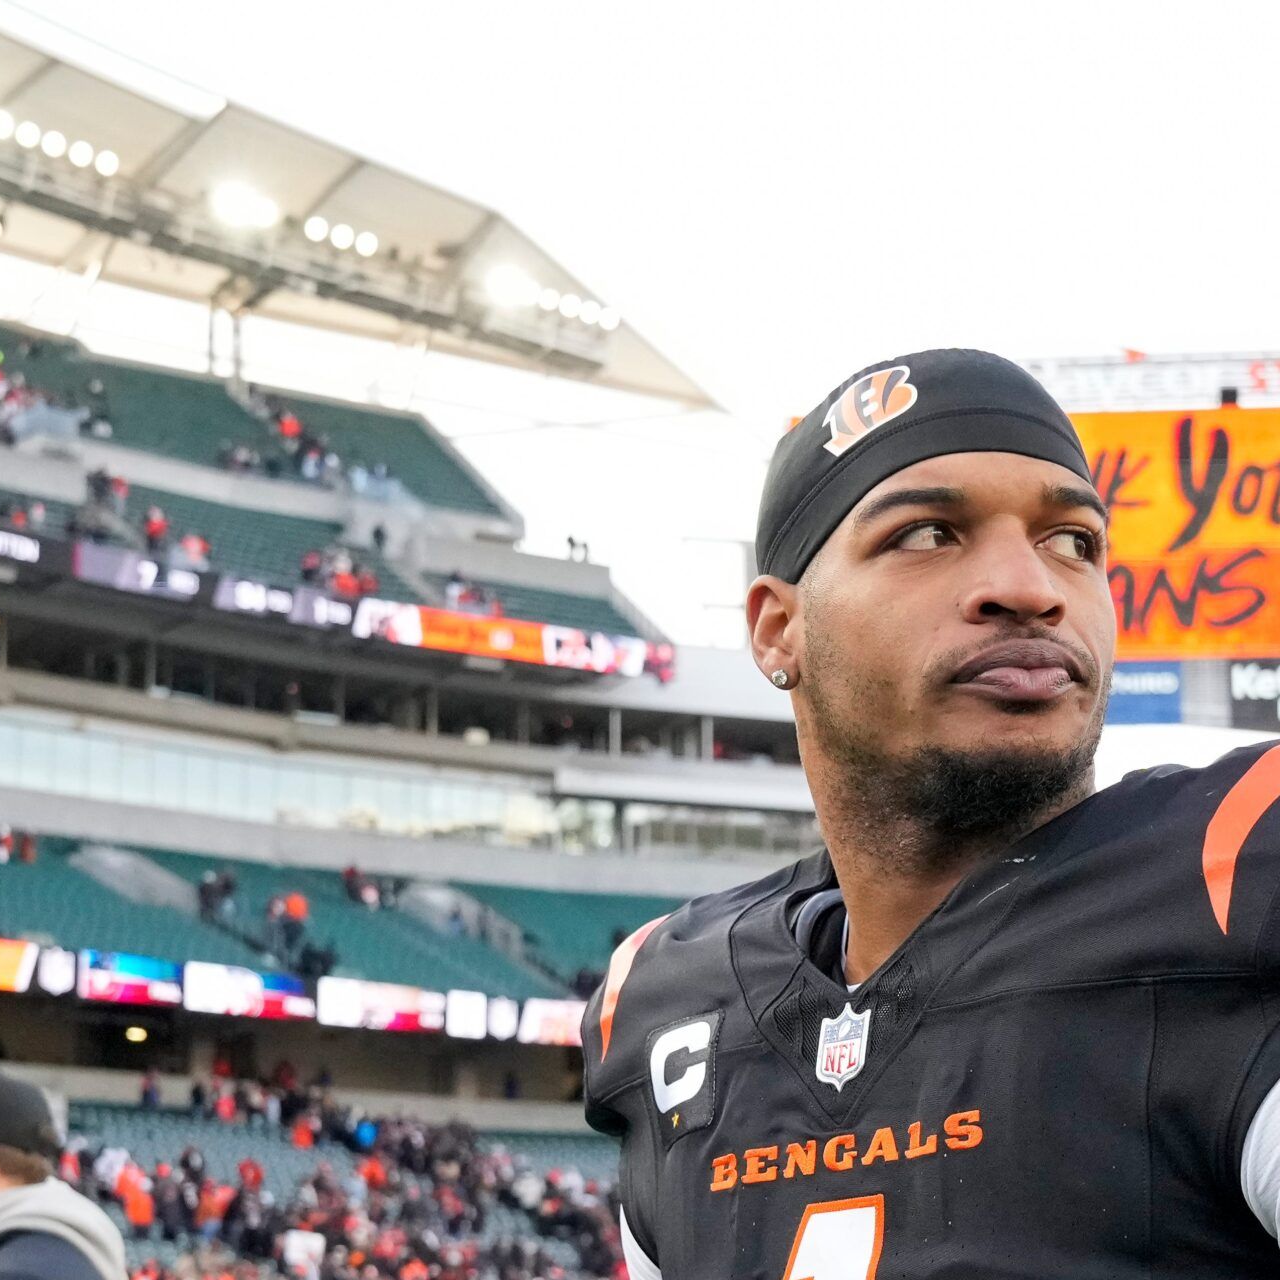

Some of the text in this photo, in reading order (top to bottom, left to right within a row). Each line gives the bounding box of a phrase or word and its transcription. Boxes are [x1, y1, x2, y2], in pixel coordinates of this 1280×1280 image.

[821, 365, 918, 458] B
[1108, 548, 1267, 632] ANS
[649, 1020, 711, 1114] C
[823, 1041, 859, 1075] NFL
[710, 1109, 985, 1193] BENGALS
